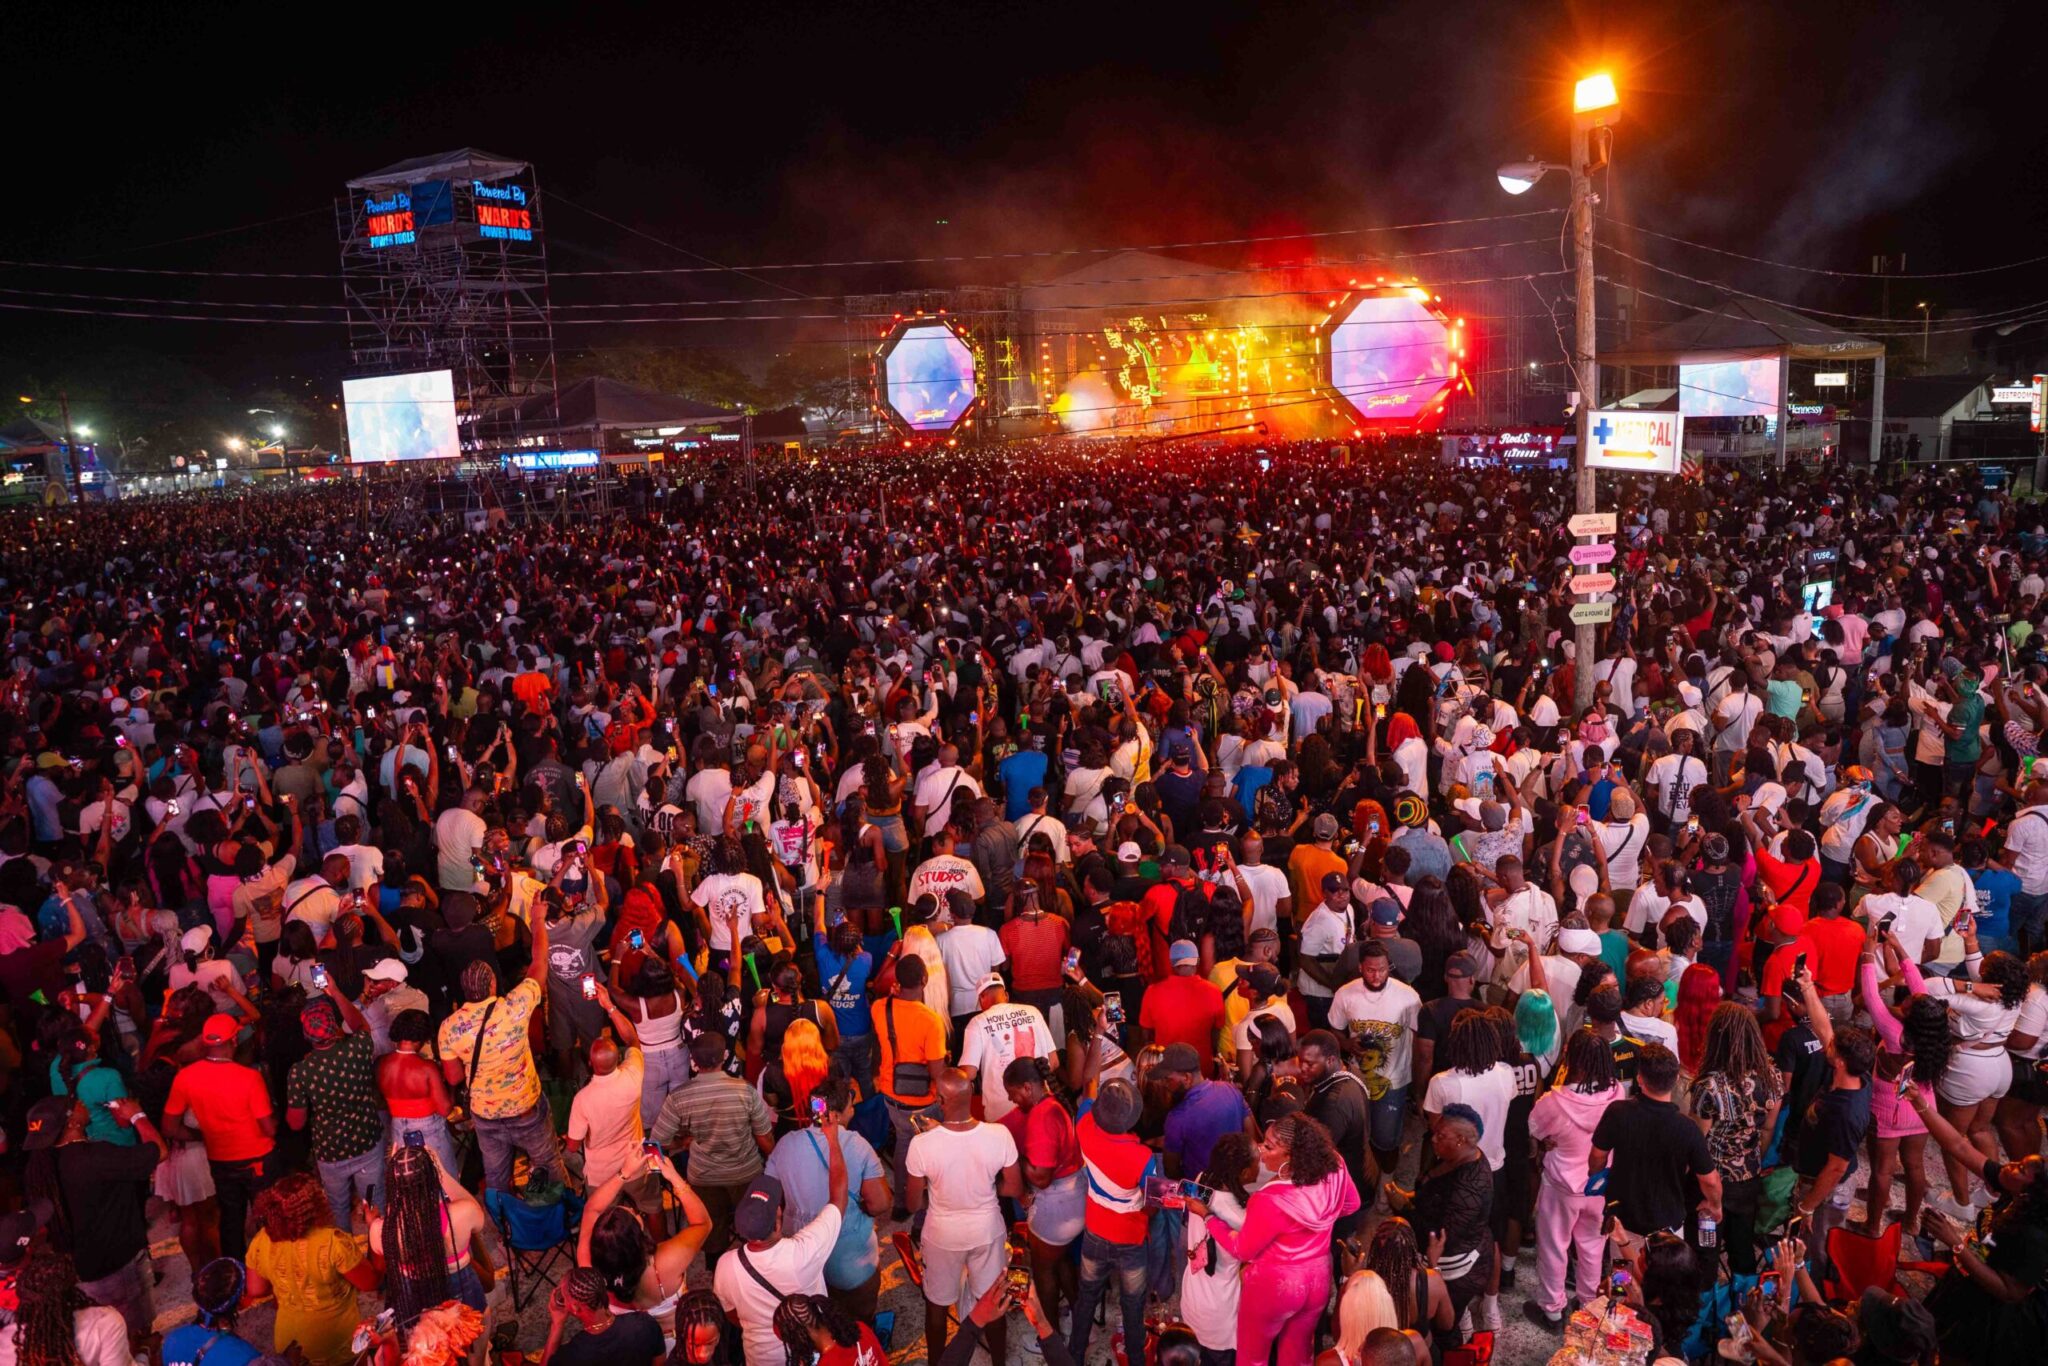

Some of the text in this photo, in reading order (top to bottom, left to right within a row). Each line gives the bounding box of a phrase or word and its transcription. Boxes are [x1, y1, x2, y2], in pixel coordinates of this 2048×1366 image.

[473, 181, 525, 205] Powered By
[398, 193, 411, 211] By
[368, 211, 413, 236] WARD'S
[478, 204, 531, 229] WARD'S
[394, 231, 415, 245] TOOLS
[480, 225, 532, 241] POWER TOOLS
[1788, 404, 1824, 416] Hennessy
[1583, 550, 1611, 558] RESTROOMS
[918, 871, 965, 886] STUDIO
[986, 1009, 1027, 1024] HOW LONG
[996, 1021, 1011, 1031] IT'S
[1011, 1015, 1036, 1028] GONE?
